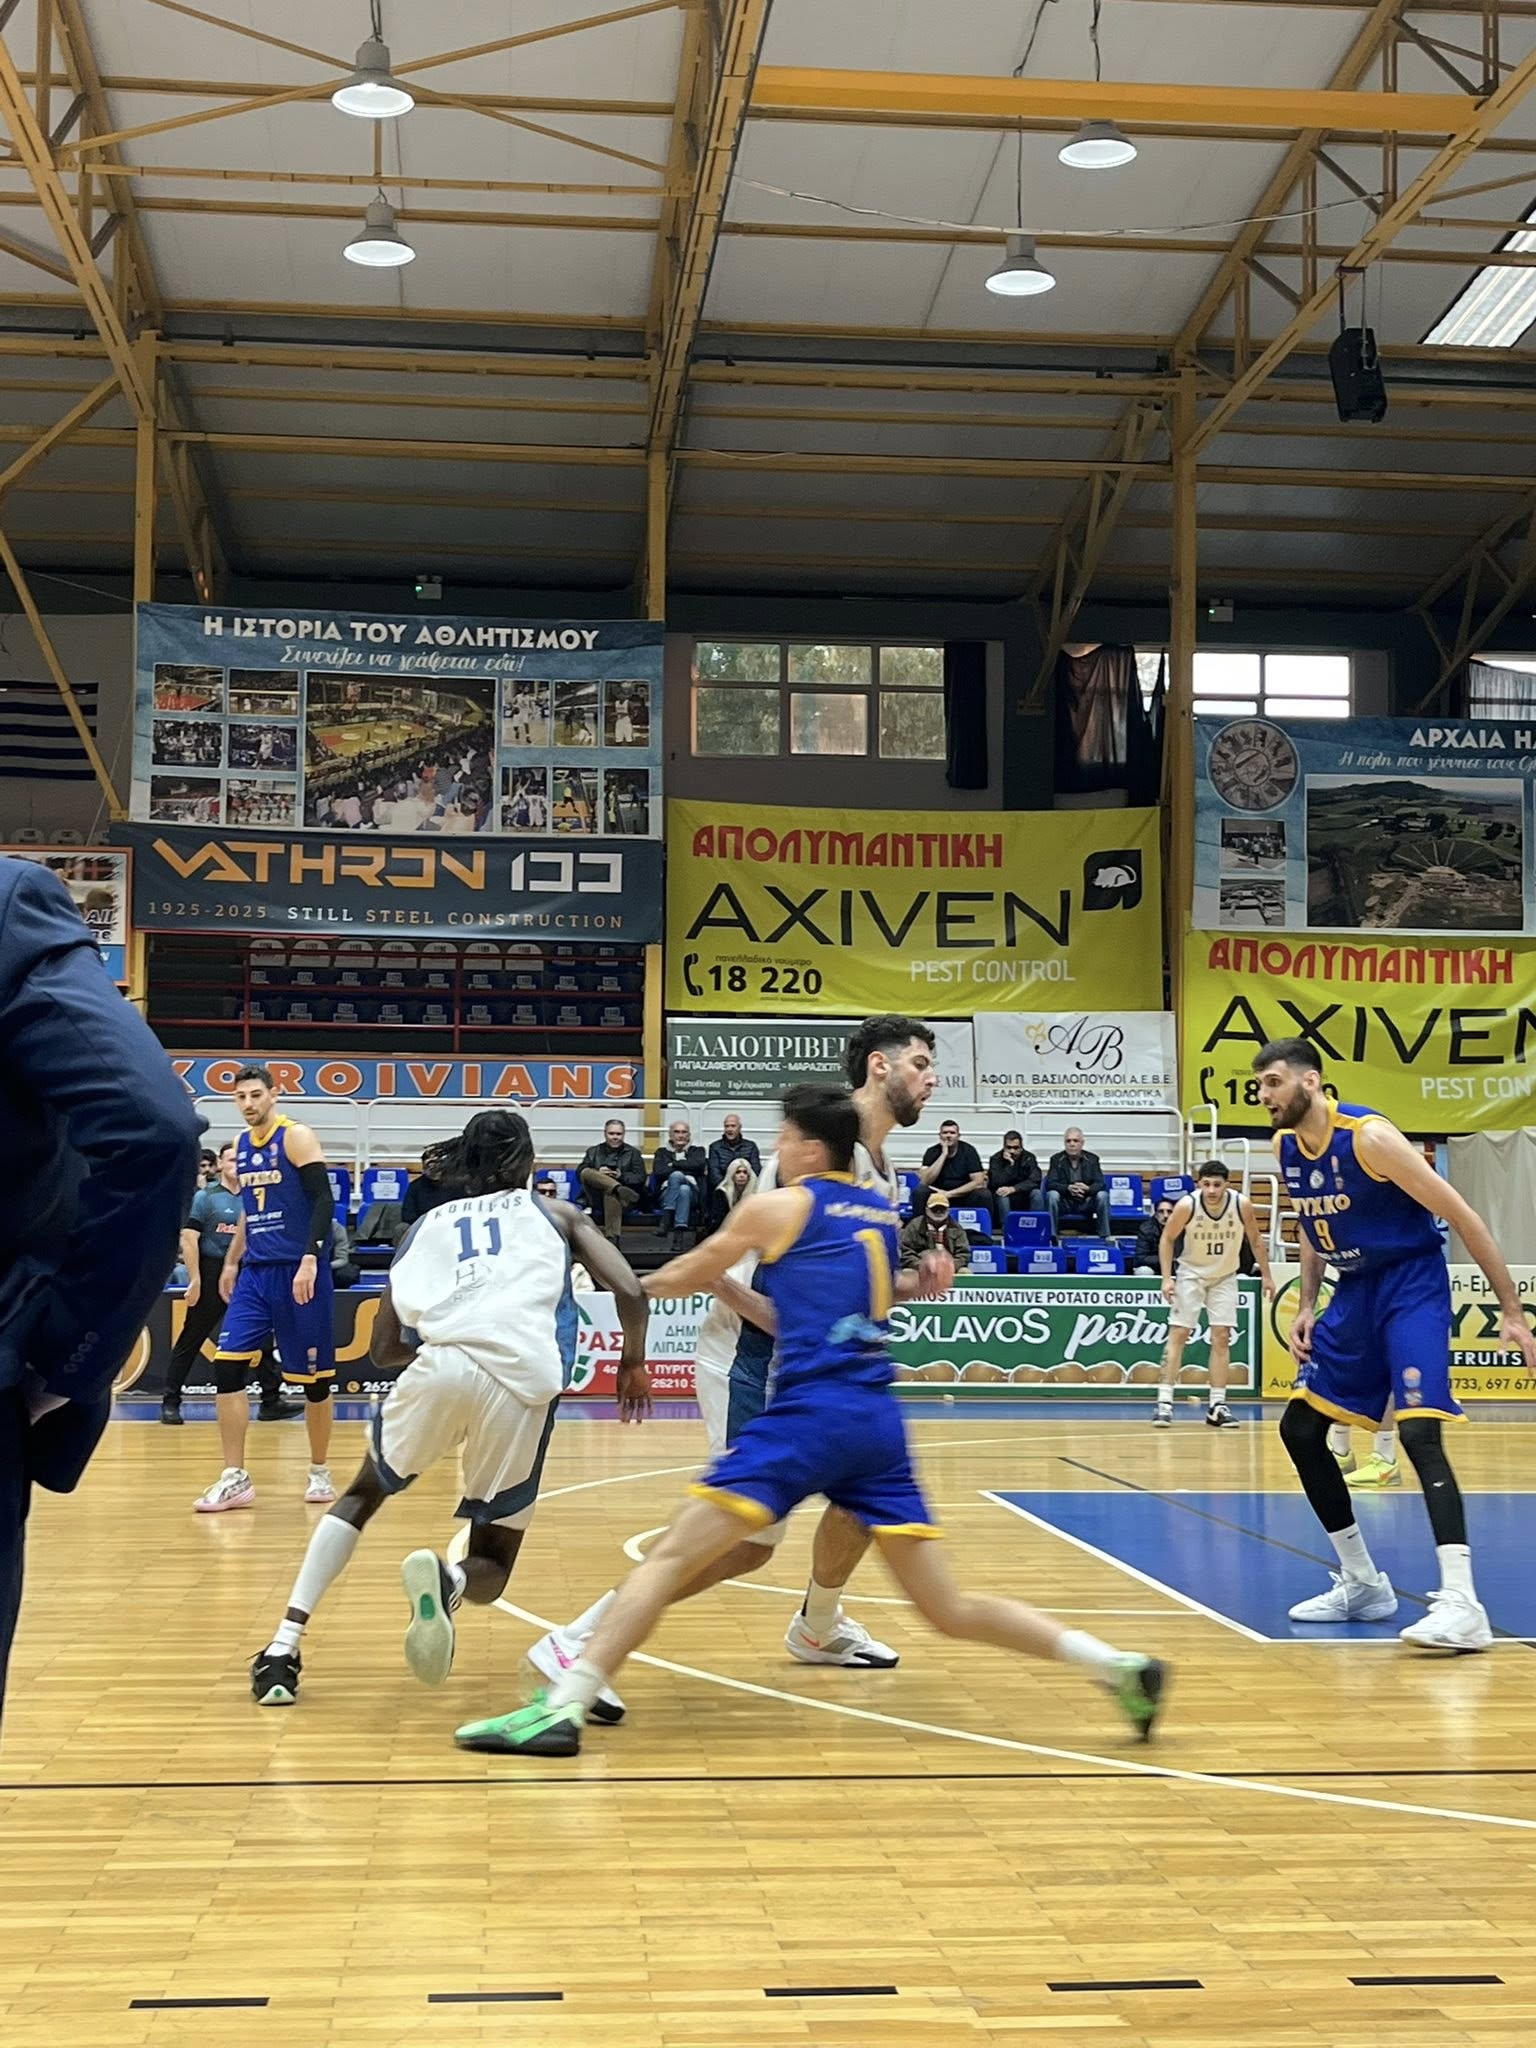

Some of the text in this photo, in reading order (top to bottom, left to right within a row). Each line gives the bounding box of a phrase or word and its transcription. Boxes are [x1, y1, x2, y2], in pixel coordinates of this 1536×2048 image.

[204, 616, 599, 650] Η ΙΣΤΟΡΙΑ ΤΟΥ ΑΘΛΗΤΙΣΜΟΥ
[369, 654, 392, 667] να
[1409, 728, 1506, 749] ΑΡΧΑΙΑ
[692, 825, 1003, 868] ΑΠΟΛΥΜΑΝΤΙΚΗ
[287, 907, 354, 922] STILL
[366, 909, 434, 925] STEEL
[447, 912, 622, 928] CONSTRUCTION
[685, 882, 1072, 948] AXIVEN
[911, 959, 1077, 983] PEST CONTROL
[1208, 937, 1513, 985] ΑΠΟΛΥΜΑΝΤΙΚΗ
[708, 965, 822, 995] 18 220
[981, 1074, 1012, 1085] ΑΦΟΙ
[1032, 1074, 1126, 1085] ΒΑΣΙΛΟΠΟΥΛΟΙ
[1421, 1077, 1476, 1099] PEST
[1104, 1089, 1162, 1098] ΒΙΟΛΟΓΙΚΑ
[1224, 1079, 1260, 1106] 18
[253, 1187, 266, 1212] 7
[454, 1216, 502, 1262] 11
[1313, 1219, 1335, 1251] 9
[1206, 1242, 1223, 1255] 10
[960, 1290, 1043, 1303] INNOVATIVE
[1047, 1291, 1100, 1304] POTATO
[1104, 1292, 1144, 1304] CROP
[1148, 1293, 1162, 1304] IN
[1454, 1351, 1522, 1365] FRUITS
[1485, 1378, 1510, 1390] 697
